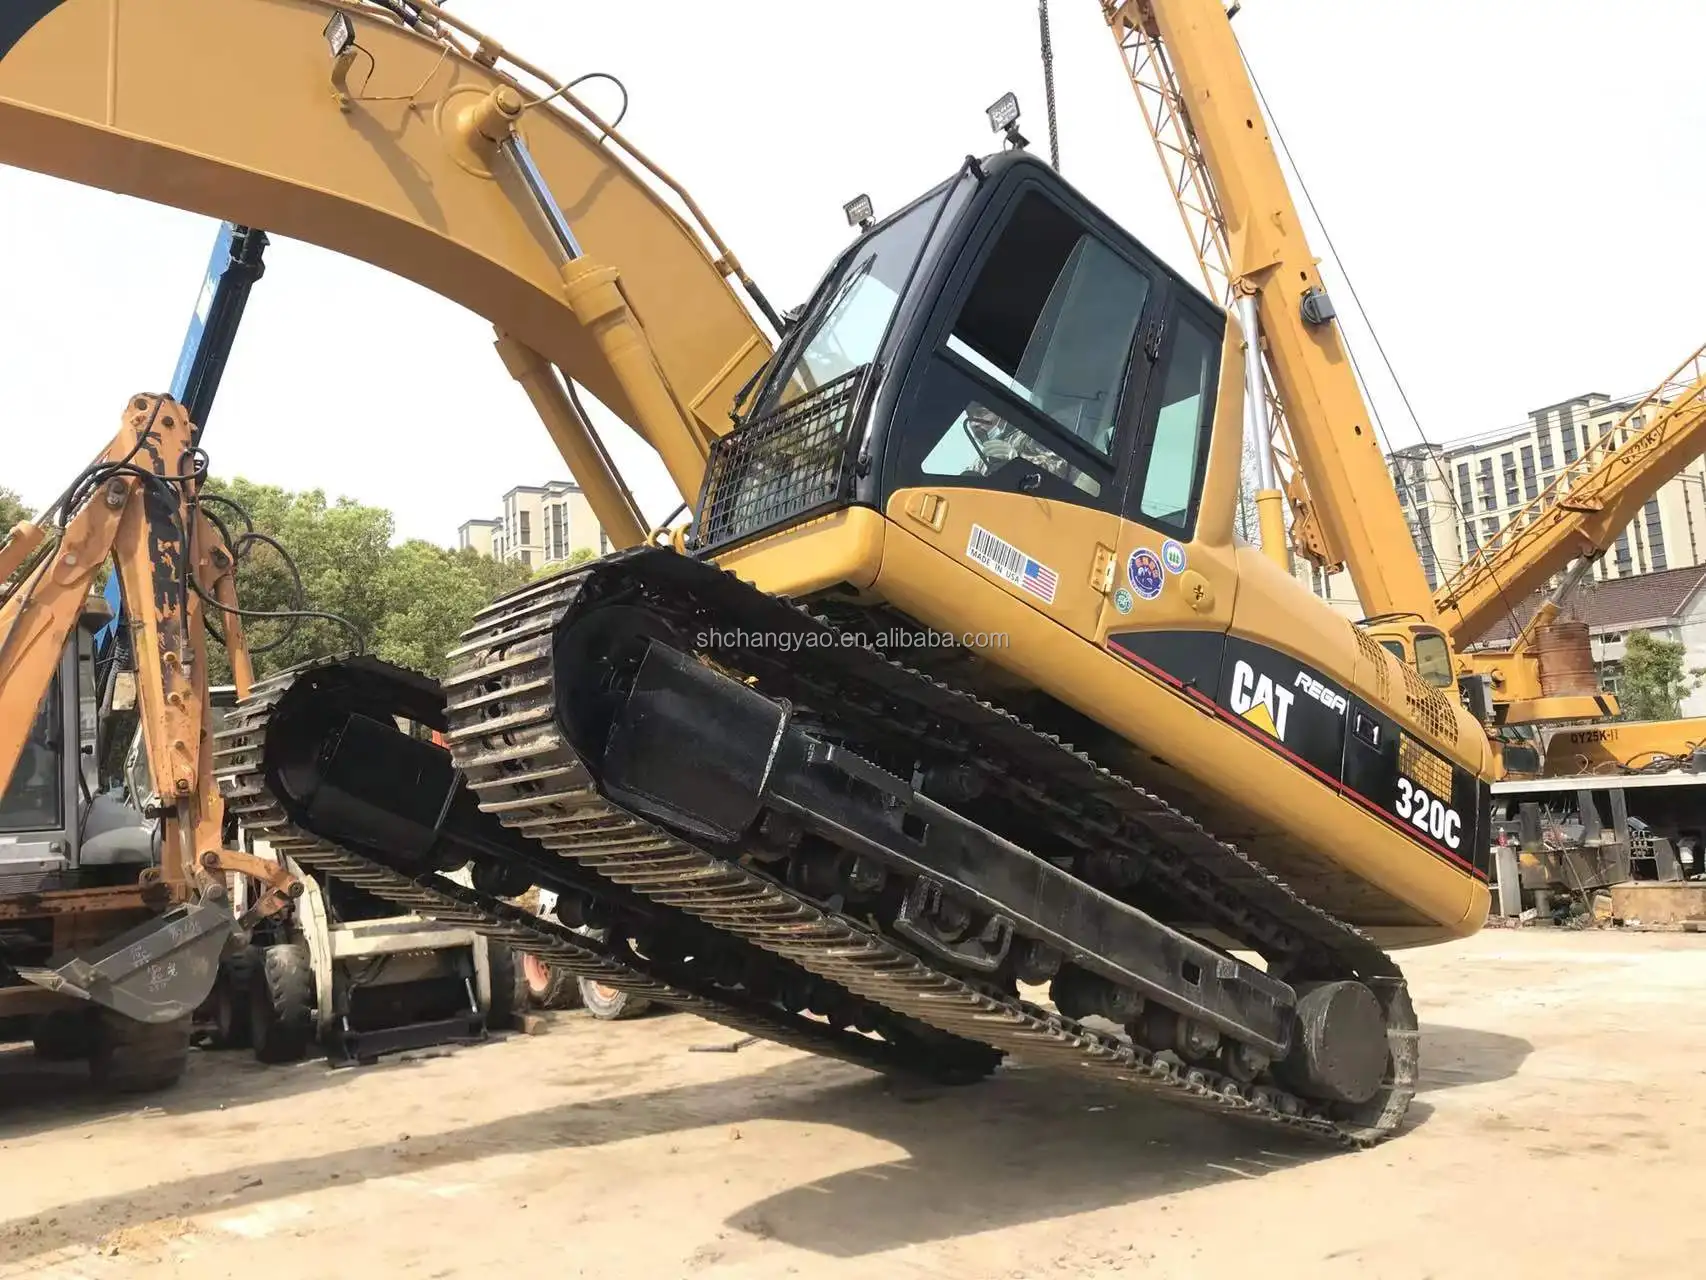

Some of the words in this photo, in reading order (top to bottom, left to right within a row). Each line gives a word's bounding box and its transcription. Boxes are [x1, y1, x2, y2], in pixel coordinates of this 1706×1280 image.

[970, 548, 991, 567] MADE
[994, 562, 1004, 574] IN
[1005, 570, 1020, 584] USA
[1229, 659, 1295, 743] CAT
[1293, 669, 1347, 716] REGA
[1395, 776, 1462, 849] 320C
